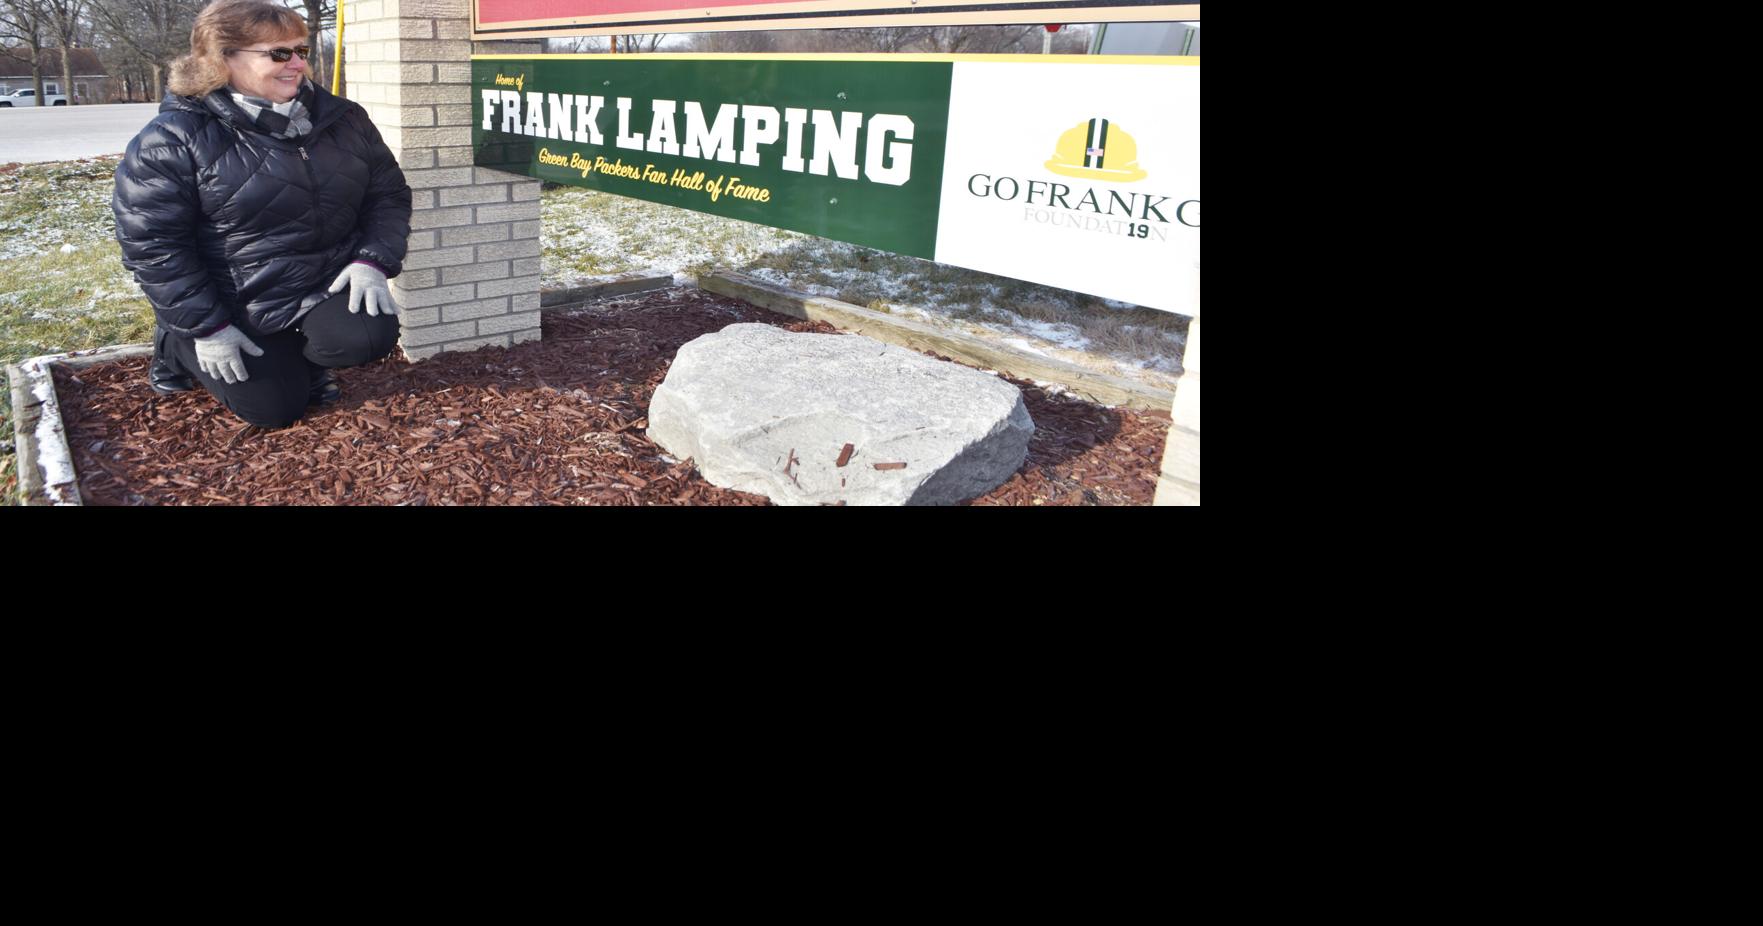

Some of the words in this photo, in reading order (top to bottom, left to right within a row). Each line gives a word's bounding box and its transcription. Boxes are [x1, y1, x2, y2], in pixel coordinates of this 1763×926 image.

[495, 74, 515, 86] Home
[515, 74, 525, 91] of
[481, 89, 605, 146] FRANK
[616, 97, 915, 186] LAMPING
[538, 148, 568, 167] Green
[570, 152, 591, 178] Bay
[593, 156, 640, 180] Packers
[642, 164, 667, 185] Fan
[670, 168, 703, 191] Hall
[705, 175, 723, 202] of
[724, 177, 770, 202] Fame
[967, 174, 1020, 201] GO
[1024, 179, 1172, 224] FRANK
